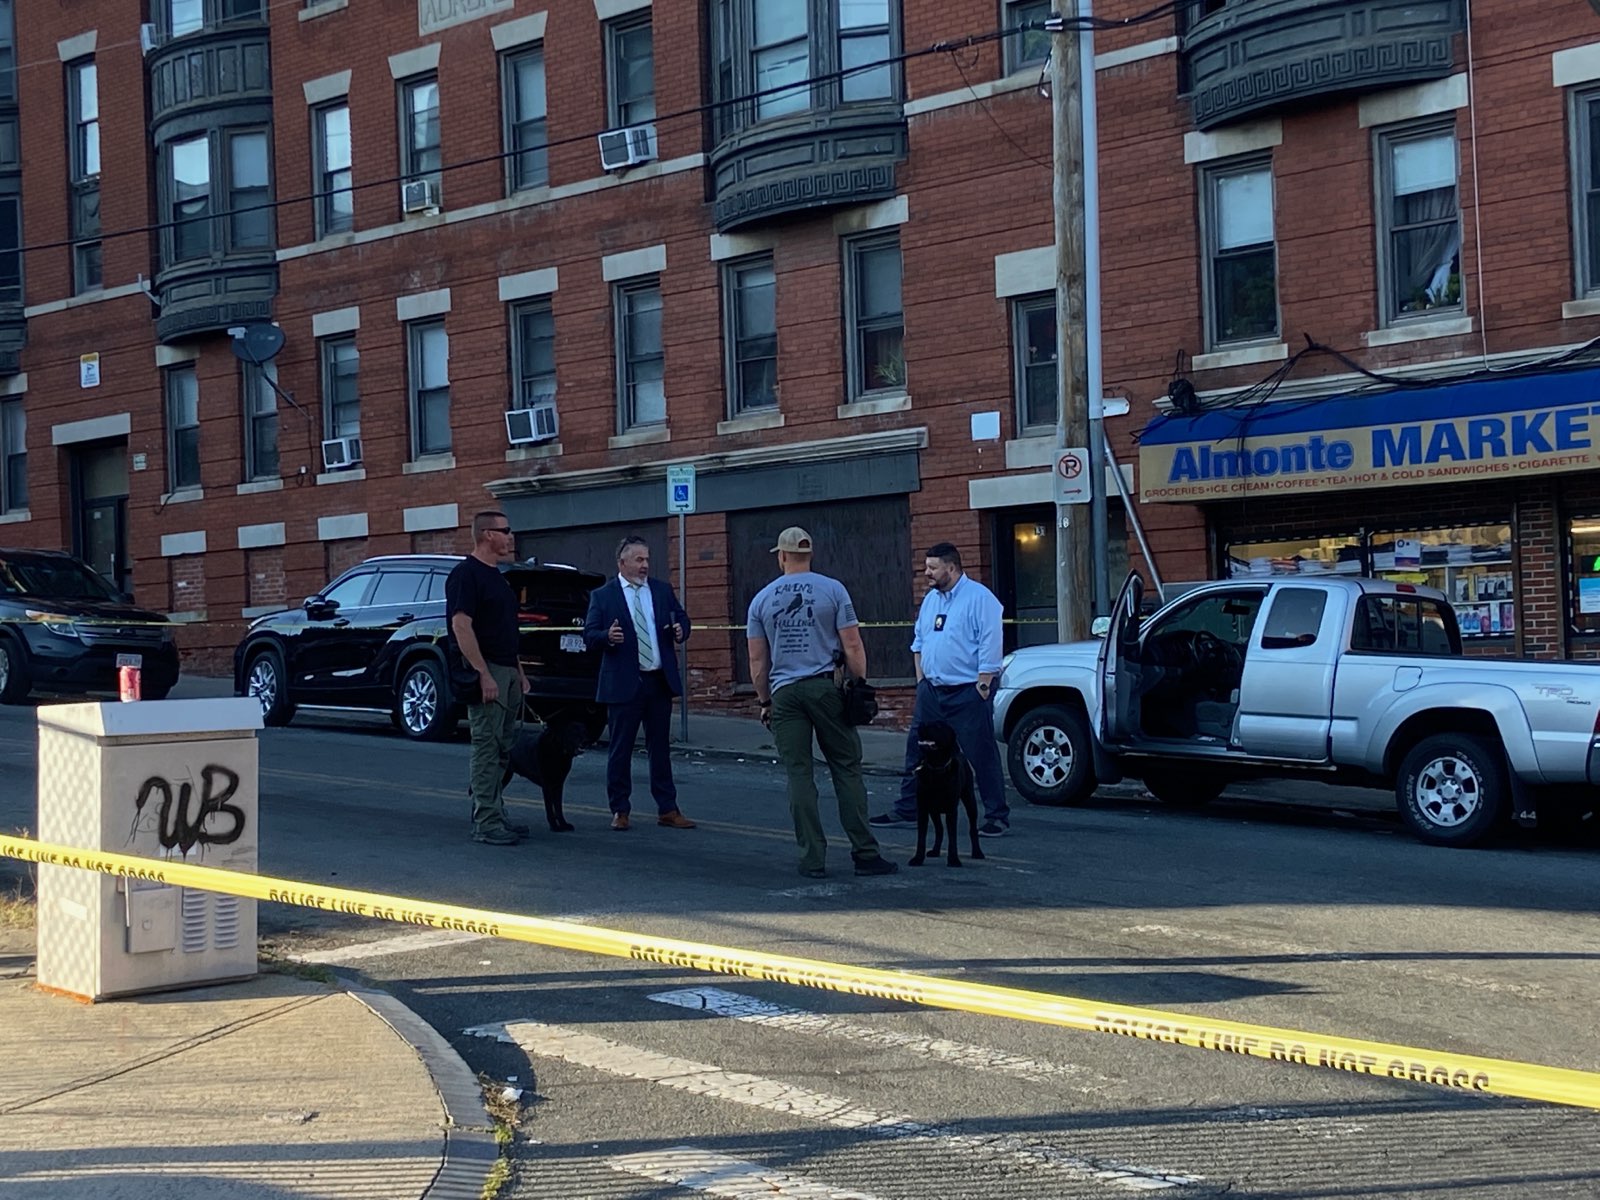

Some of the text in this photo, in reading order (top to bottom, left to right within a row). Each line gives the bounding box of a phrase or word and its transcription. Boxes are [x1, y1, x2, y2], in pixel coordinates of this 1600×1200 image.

[1145, 454, 1590, 498] GROCERIES ICE CREAM COFFEE TEA HOT & COLD SANDWICHES CIGARETTE
[1168, 435, 1354, 483] Almonte
